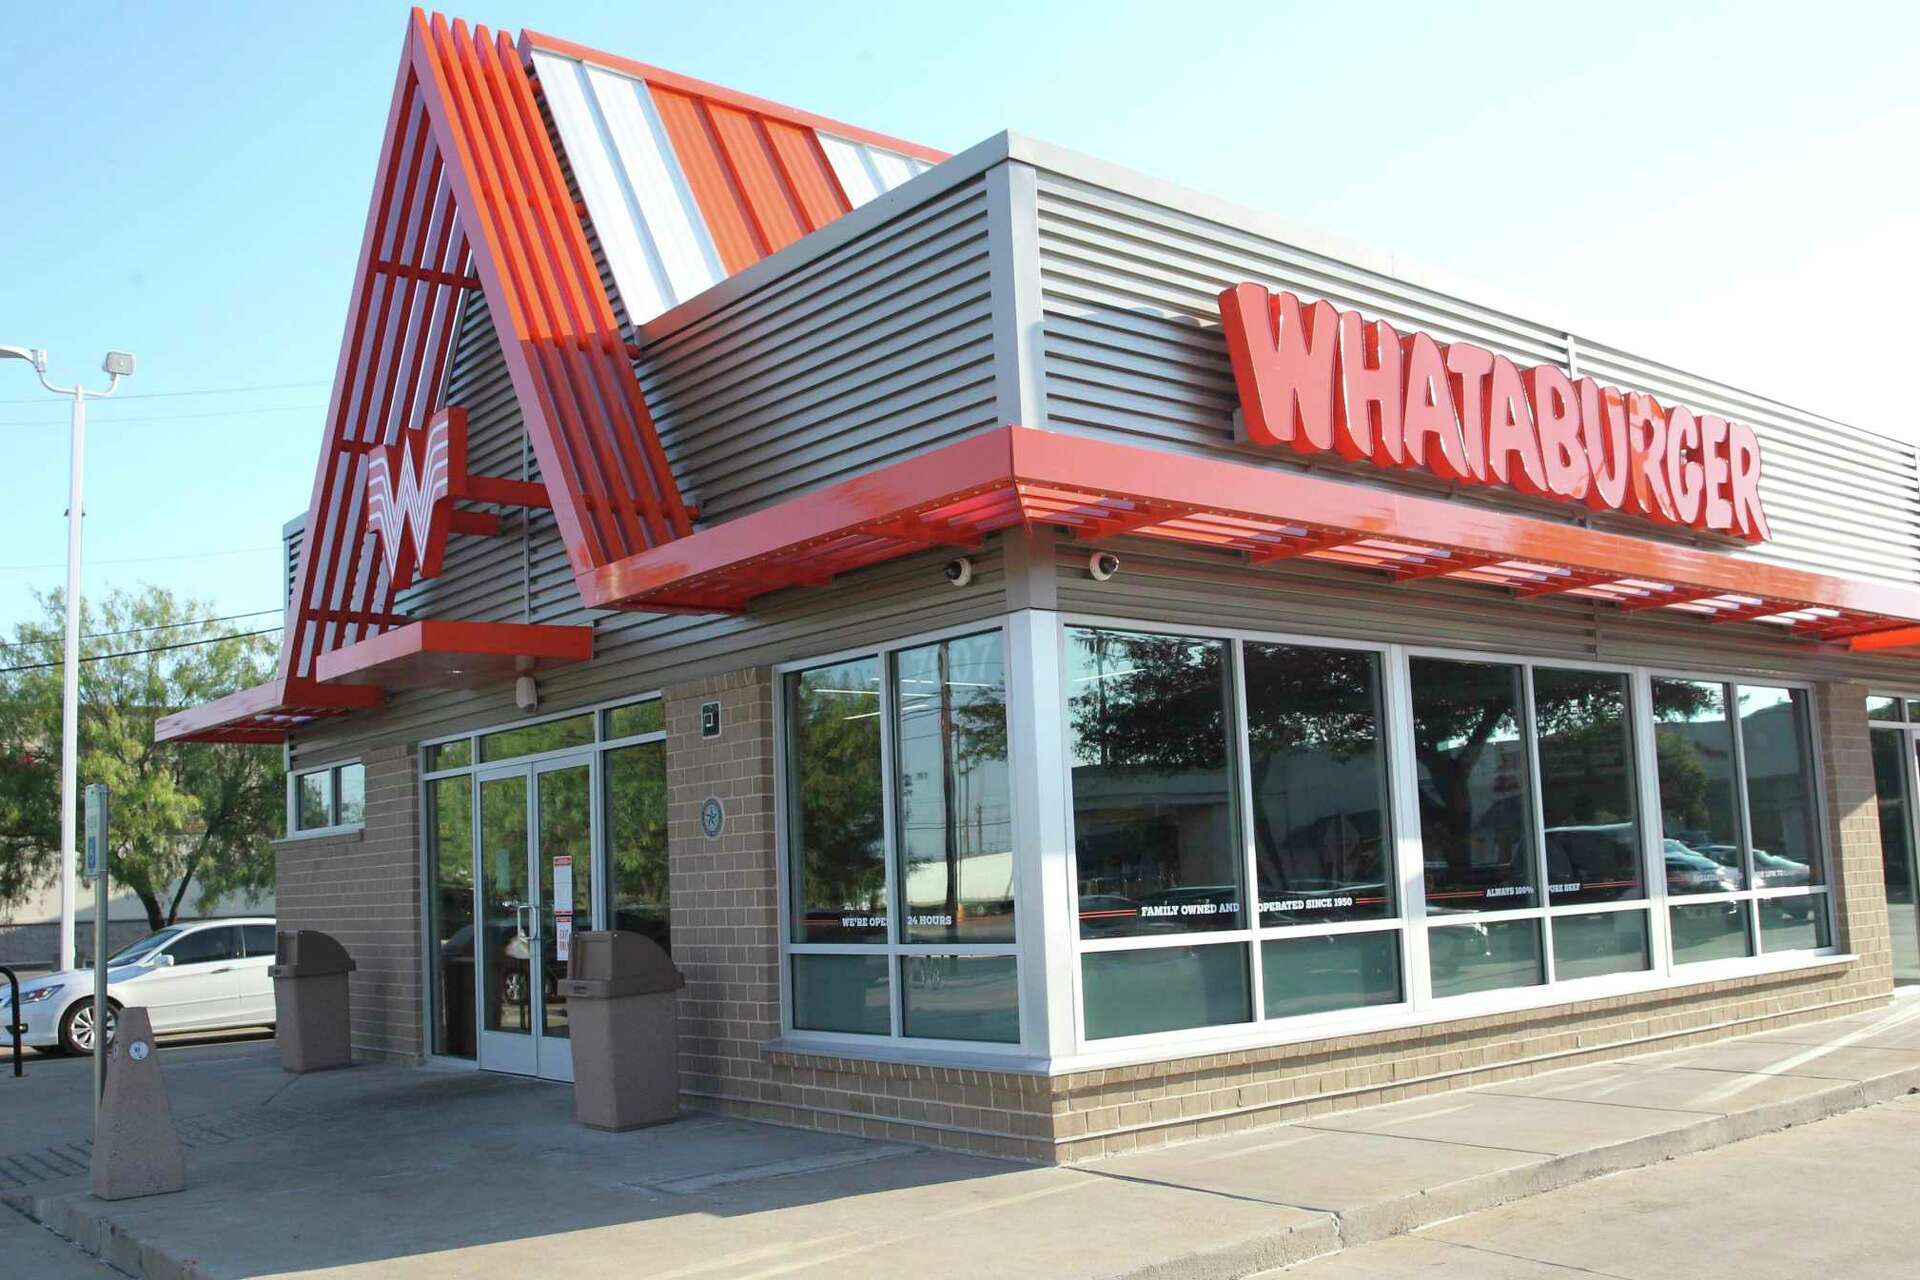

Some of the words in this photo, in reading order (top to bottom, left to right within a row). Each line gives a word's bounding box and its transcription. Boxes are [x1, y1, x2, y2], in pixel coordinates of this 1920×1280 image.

[1219, 282, 1771, 543] WHATABURGER
[367, 407, 456, 585] W
[1486, 887, 1514, 897] ALWAYS
[1141, 905, 1179, 917] FAMILY
[1180, 903, 1217, 915] OWNED
[1218, 902, 1240, 914] AND
[1257, 900, 1304, 912] OPERATED
[1305, 898, 1332, 909] SINCE
[1333, 897, 1352, 907] 1950
[842, 917, 868, 927] WE'RE
[869, 917, 888, 927] OPE
[907, 915, 918, 925] 24
[919, 915, 952, 925] HOURS
